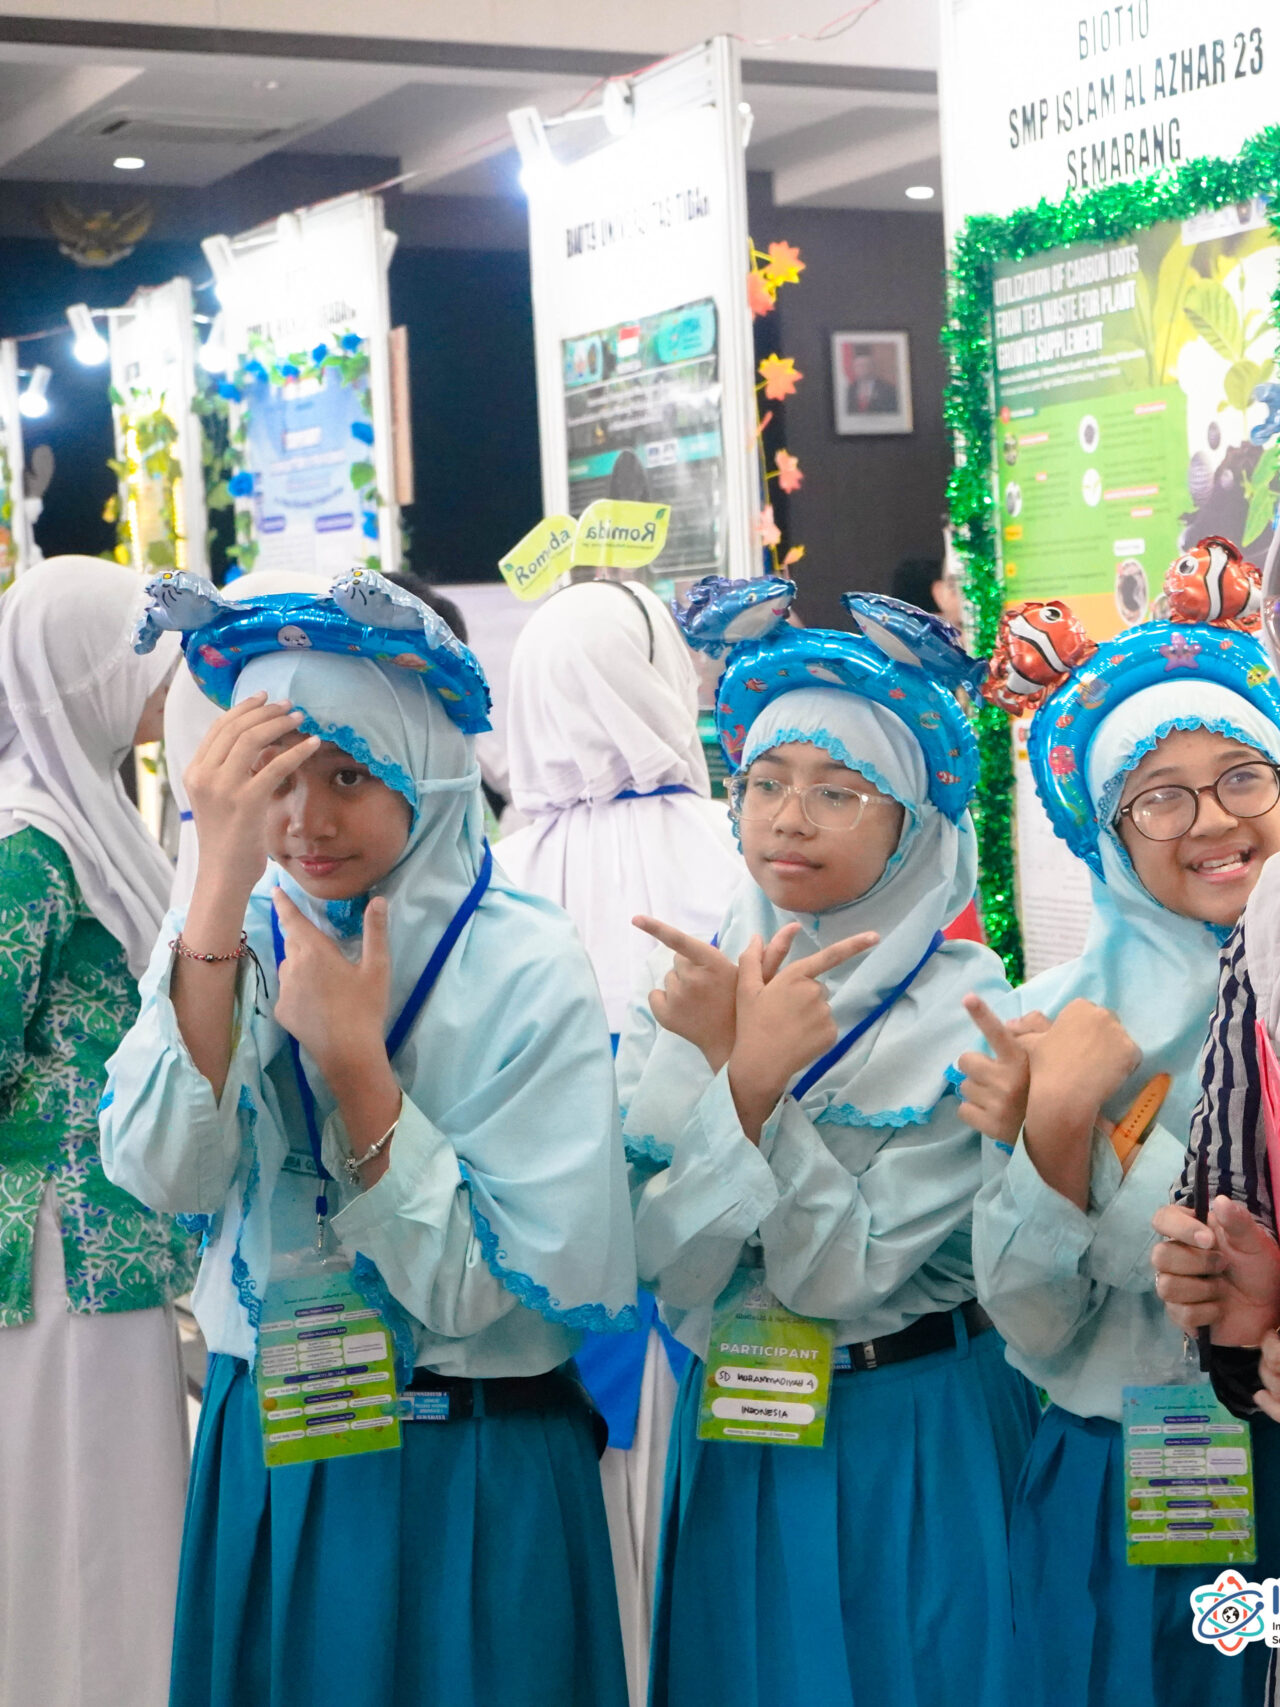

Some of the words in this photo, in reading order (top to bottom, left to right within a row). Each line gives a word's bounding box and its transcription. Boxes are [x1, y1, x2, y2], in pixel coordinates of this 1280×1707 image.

[1078, 0, 1150, 60] BIOT10
[1009, 98, 1049, 149] SMP
[1056, 74, 1116, 134] ISLAM
[1125, 64, 1146, 111] AL
[1154, 39, 1226, 101] AZHAR
[1234, 27, 1264, 79] 23
[1067, 117, 1181, 190] SEMARANG
[720, 1343, 819, 1360] PARTICIPANT
[718, 1370, 731, 1382] SD
[741, 1405, 789, 1419] INDONESIA
